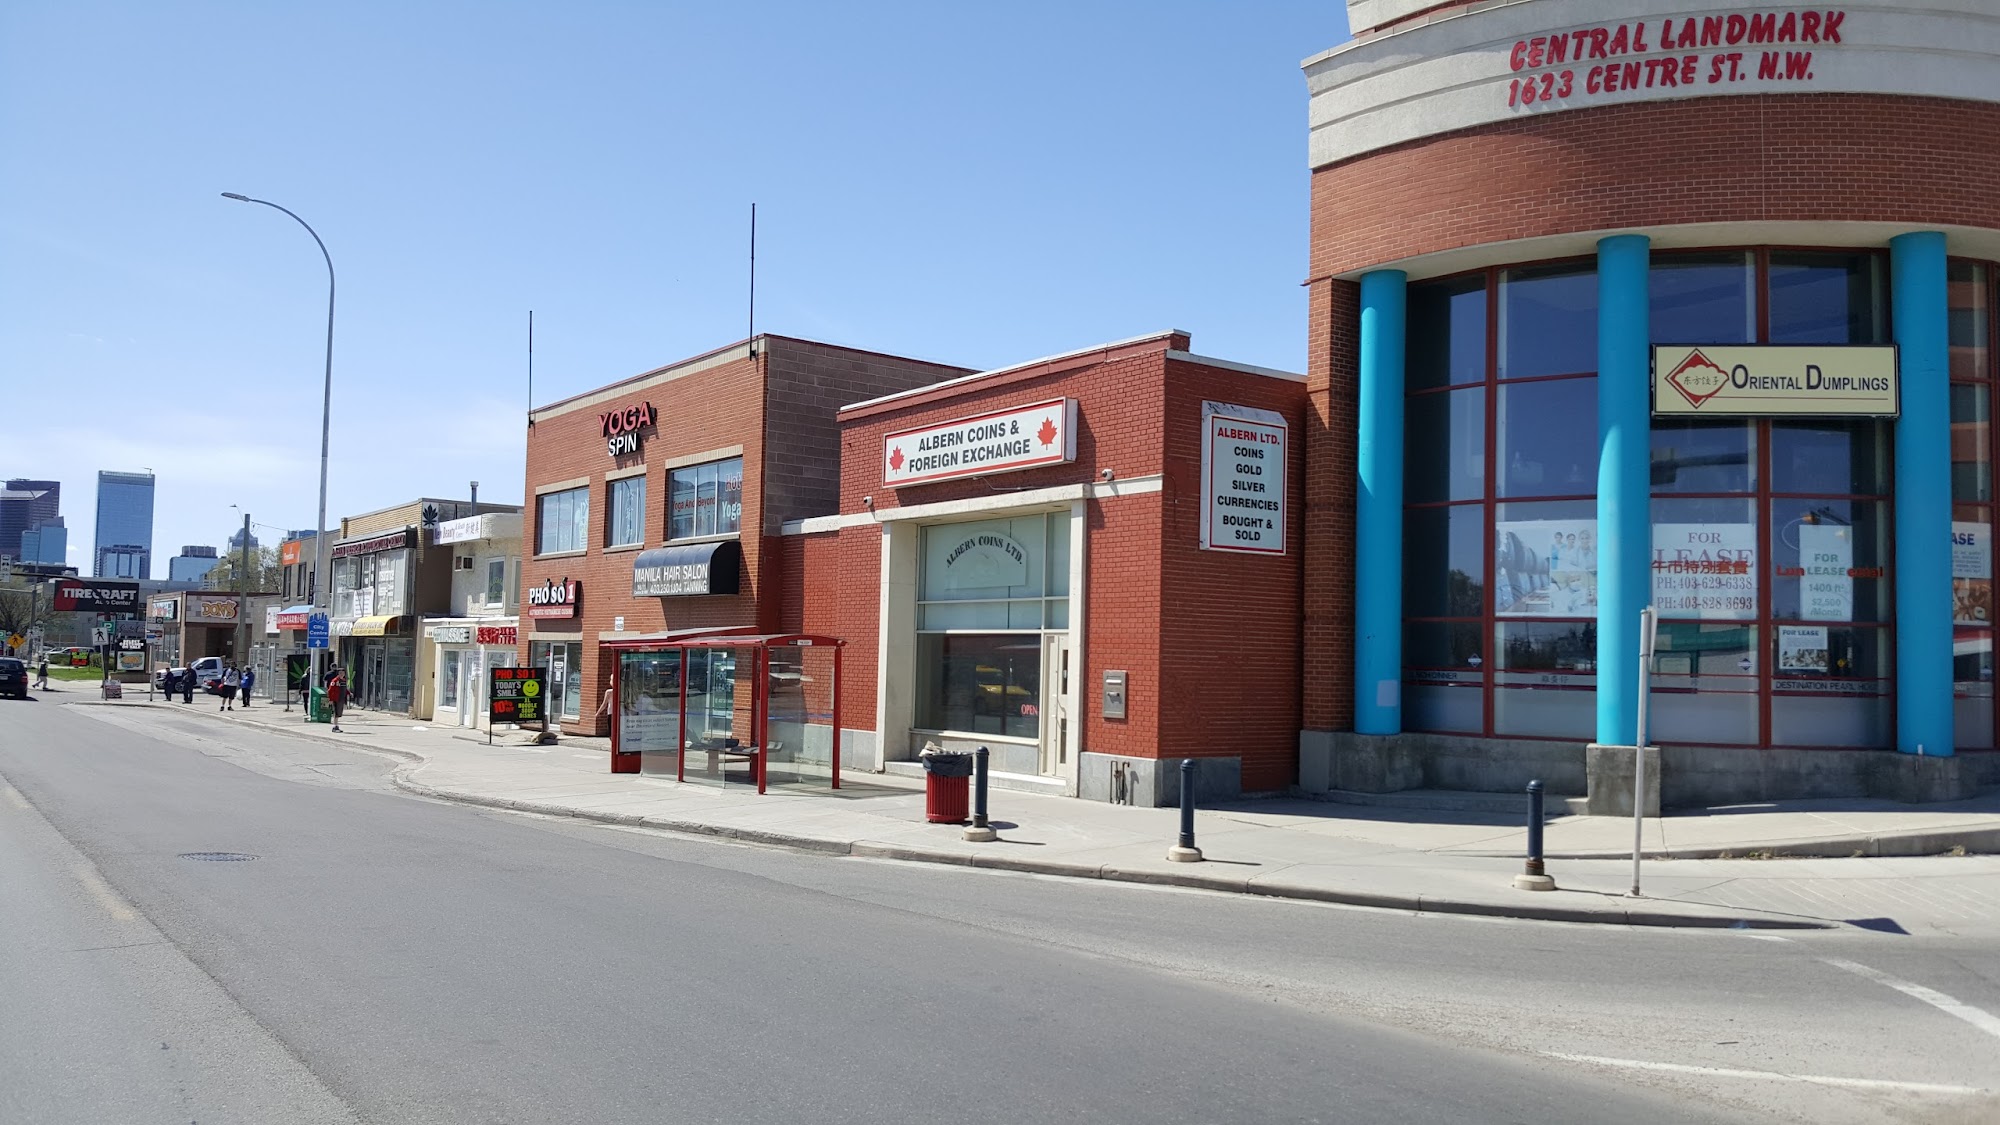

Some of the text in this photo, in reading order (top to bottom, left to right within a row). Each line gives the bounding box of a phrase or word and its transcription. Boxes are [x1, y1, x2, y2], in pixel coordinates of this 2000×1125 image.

[1510, 11, 1845, 71] CENTRAL LANDMARK
[1509, 52, 1813, 106] 1623 CENTRE ST. N.W.
[598, 401, 651, 437] YOGA
[918, 420, 1019, 452] ALBERN COINS &
[1217, 427, 1280, 445] ALBERN LTD.
[608, 433, 637, 456] SPIN
[909, 439, 1031, 473] FOREIGN EXCHANGE
[1234, 446, 1264, 459] COINS
[1236, 463, 1262, 475] GOLD
[1232, 480, 1265, 493] SILVER
[1217, 495, 1279, 511] CURRENCIES
[722, 501, 742, 520] Yoga
[1223, 515, 1273, 529] BOUGHT &
[1235, 530, 1261, 541] SOLD
[1688, 532, 1721, 543] FOR
[1952, 533, 1975, 546] ASE
[946, 536, 1023, 568] ALBERN COINS LTD.
[1814, 553, 1839, 562] FOR
[634, 563, 708, 583] MANILA HAIR SALON
[1806, 567, 1846, 576] LEASE
[62, 587, 137, 600] TIRECRAFT
[1808, 584, 1832, 592] 1400
[495, 669, 513, 679] PHO
[516, 669, 529, 679] SO
[495, 681, 522, 690] TODAY'S
[1776, 681, 1828, 690] DESTINATION
[497, 689, 517, 697] SMILE
[1020, 703, 1039, 716] OPEN
